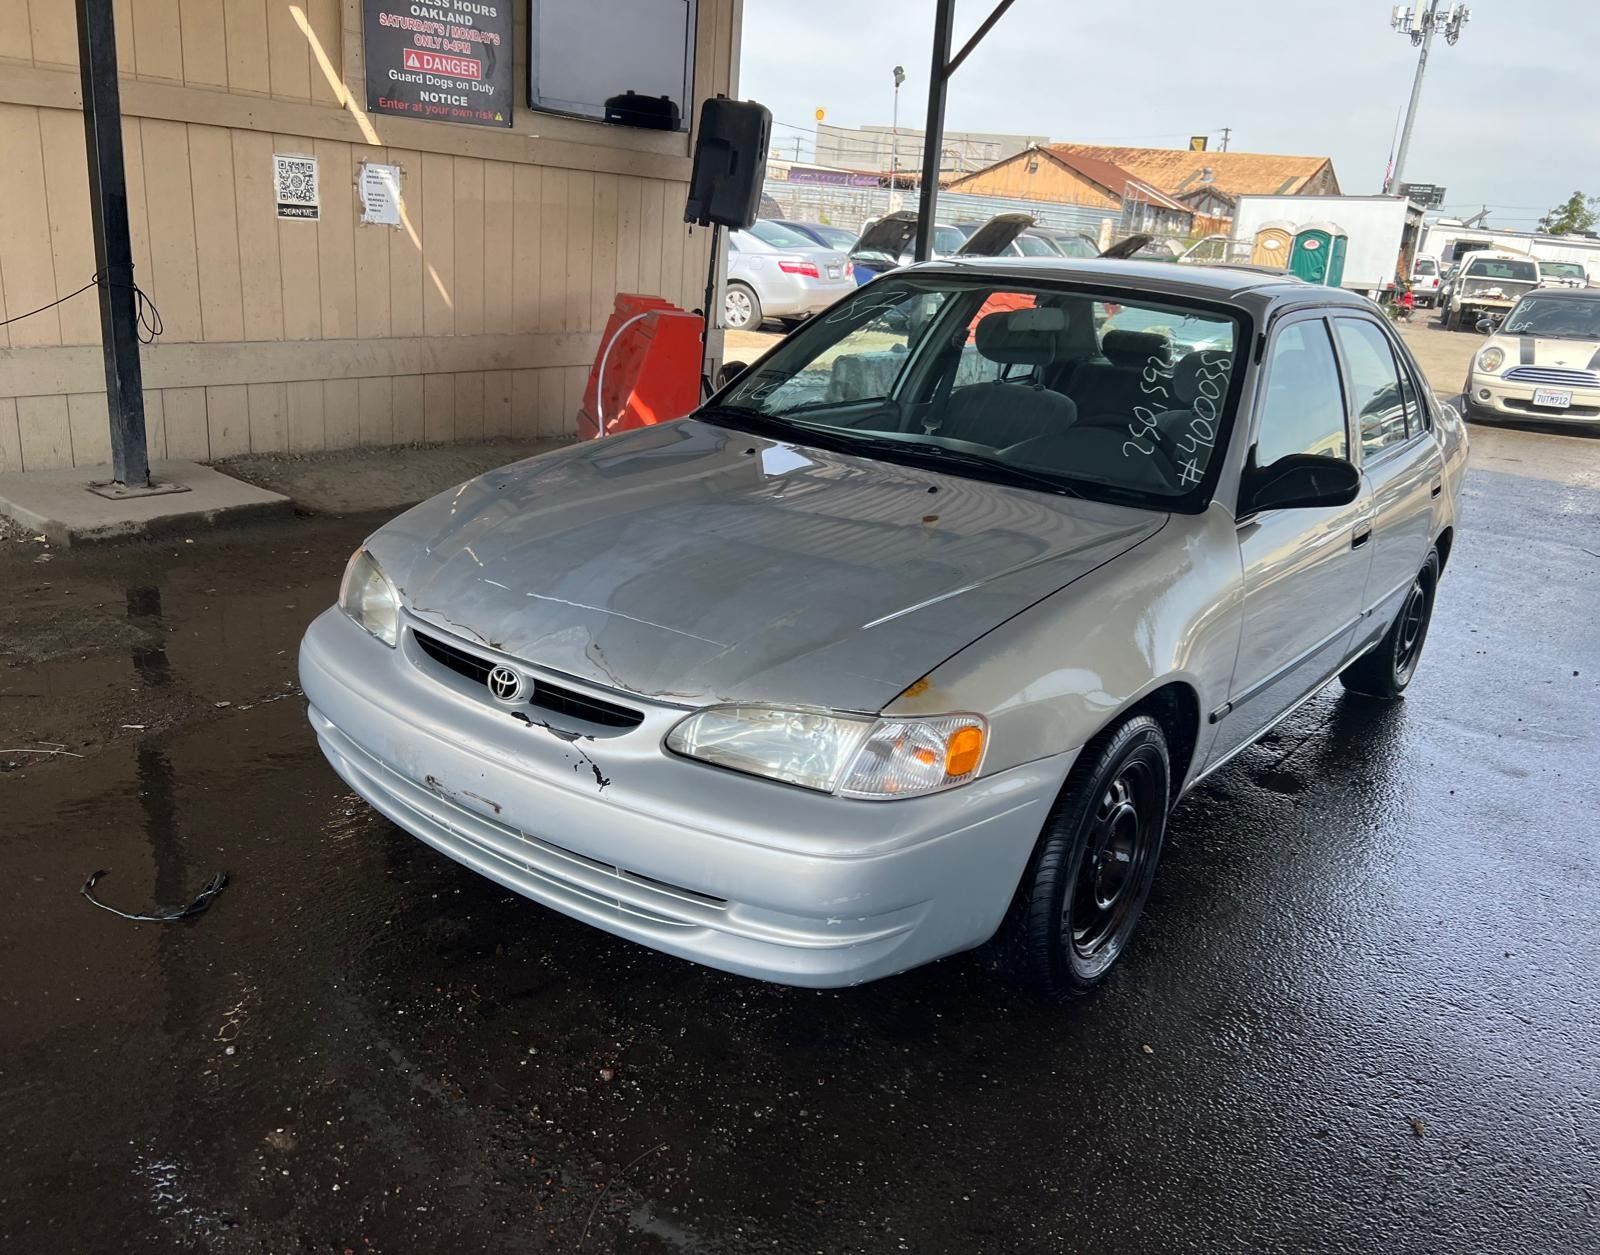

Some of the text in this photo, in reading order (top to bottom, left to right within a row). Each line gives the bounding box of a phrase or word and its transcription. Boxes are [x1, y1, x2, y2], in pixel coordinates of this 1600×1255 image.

[410, 5, 473, 26] OAKLAND
[453, 0, 497, 18] HOURS
[414, 34, 471, 54] ONLY 9-4PM
[423, 55, 478, 76] DANGER
[388, 69, 495, 96] Guard Dogs on Duty
[378, 97, 494, 120] Enter at your own risk
[420, 91, 468, 106] NOTICE
[283, 207, 314, 217] SCAN ME
